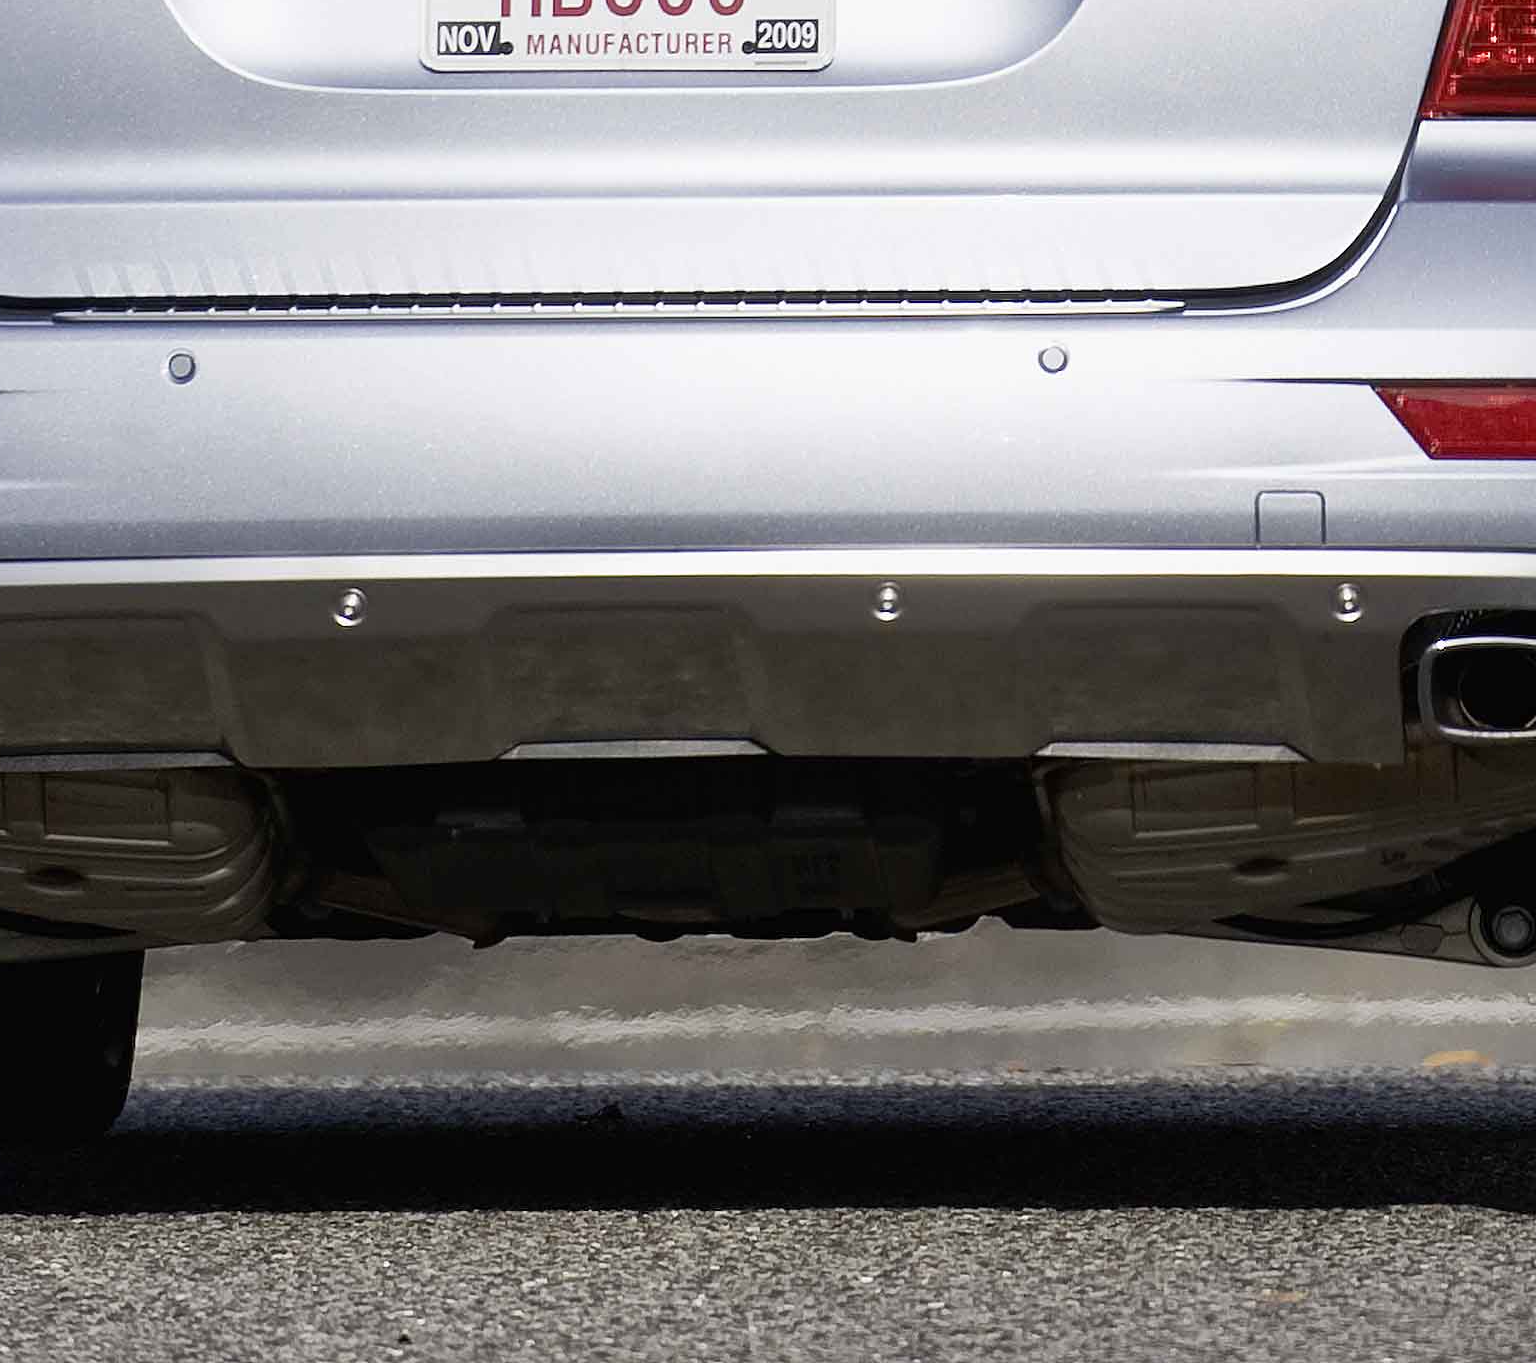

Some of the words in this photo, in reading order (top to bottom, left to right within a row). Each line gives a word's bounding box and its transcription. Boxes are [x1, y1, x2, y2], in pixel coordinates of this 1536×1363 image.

[438, 25, 496, 54] NOV
[526, 34, 733, 54] MANUFACTURER
[758, 21, 817, 50] 2009
